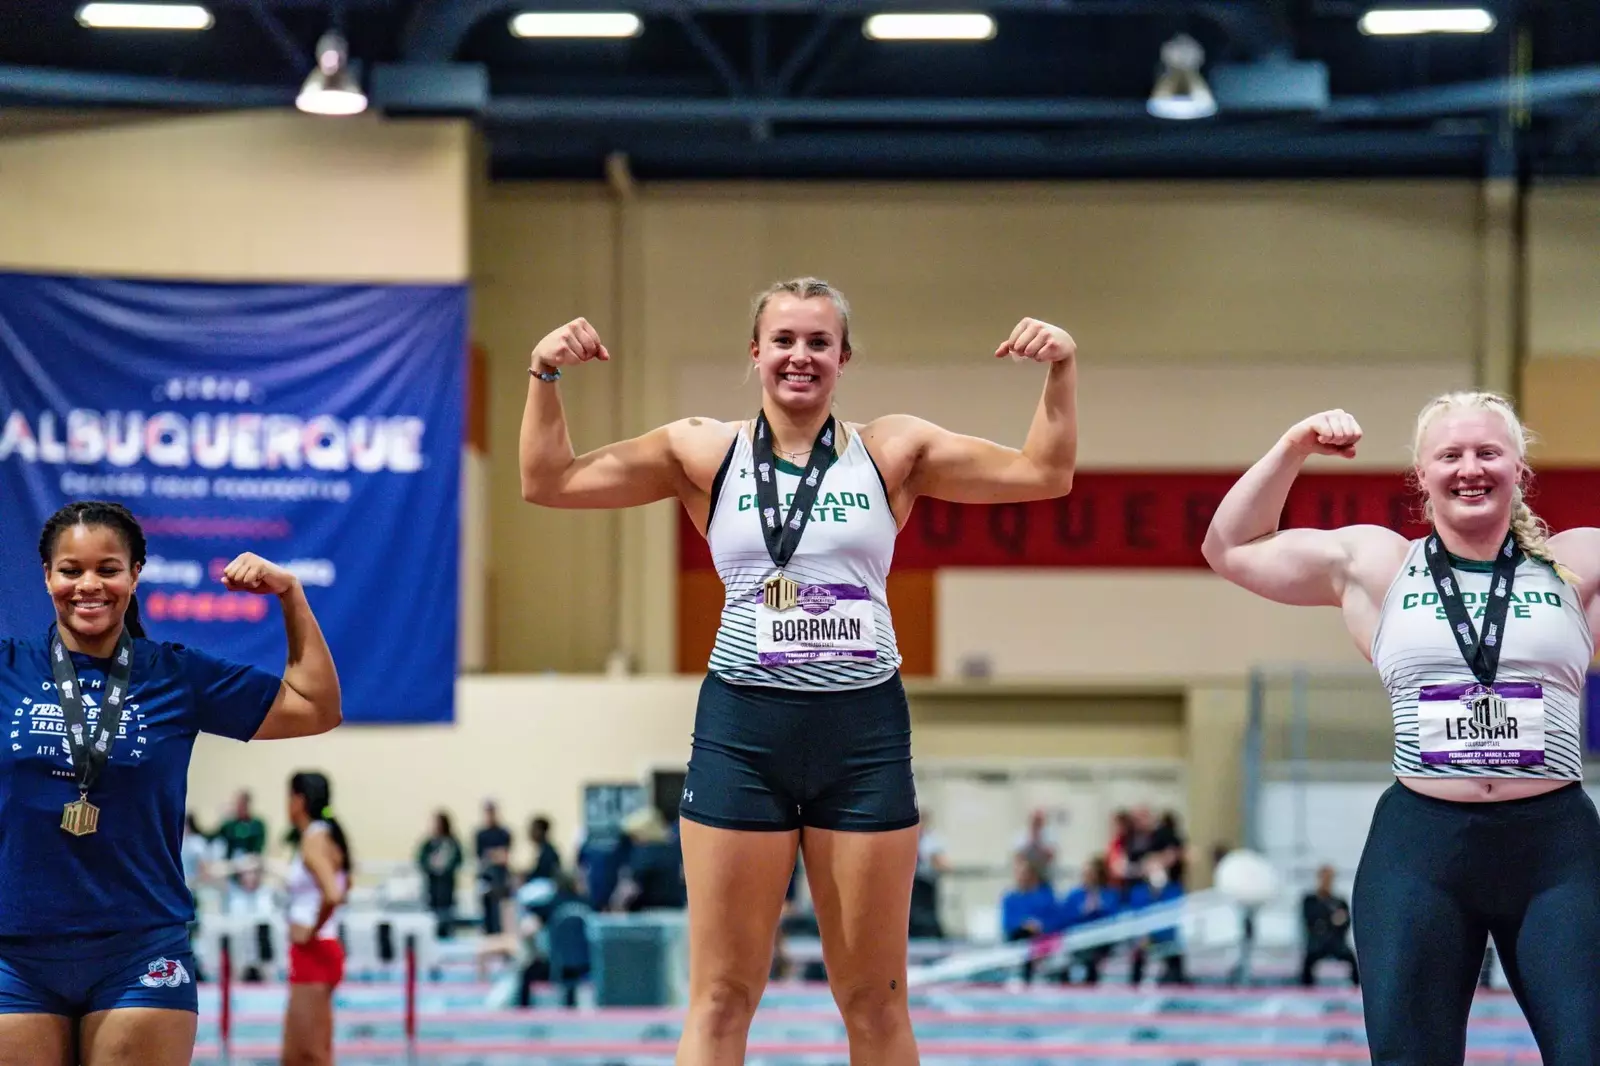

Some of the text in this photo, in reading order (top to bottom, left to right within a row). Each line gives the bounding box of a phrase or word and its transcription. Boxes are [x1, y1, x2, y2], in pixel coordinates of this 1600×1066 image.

[0, 407, 425, 473] ALBUQUERQUE
[773, 618, 861, 642] BORRMAN
[10, 696, 33, 752] PRIDE
[36, 745, 59, 757] ATH.
